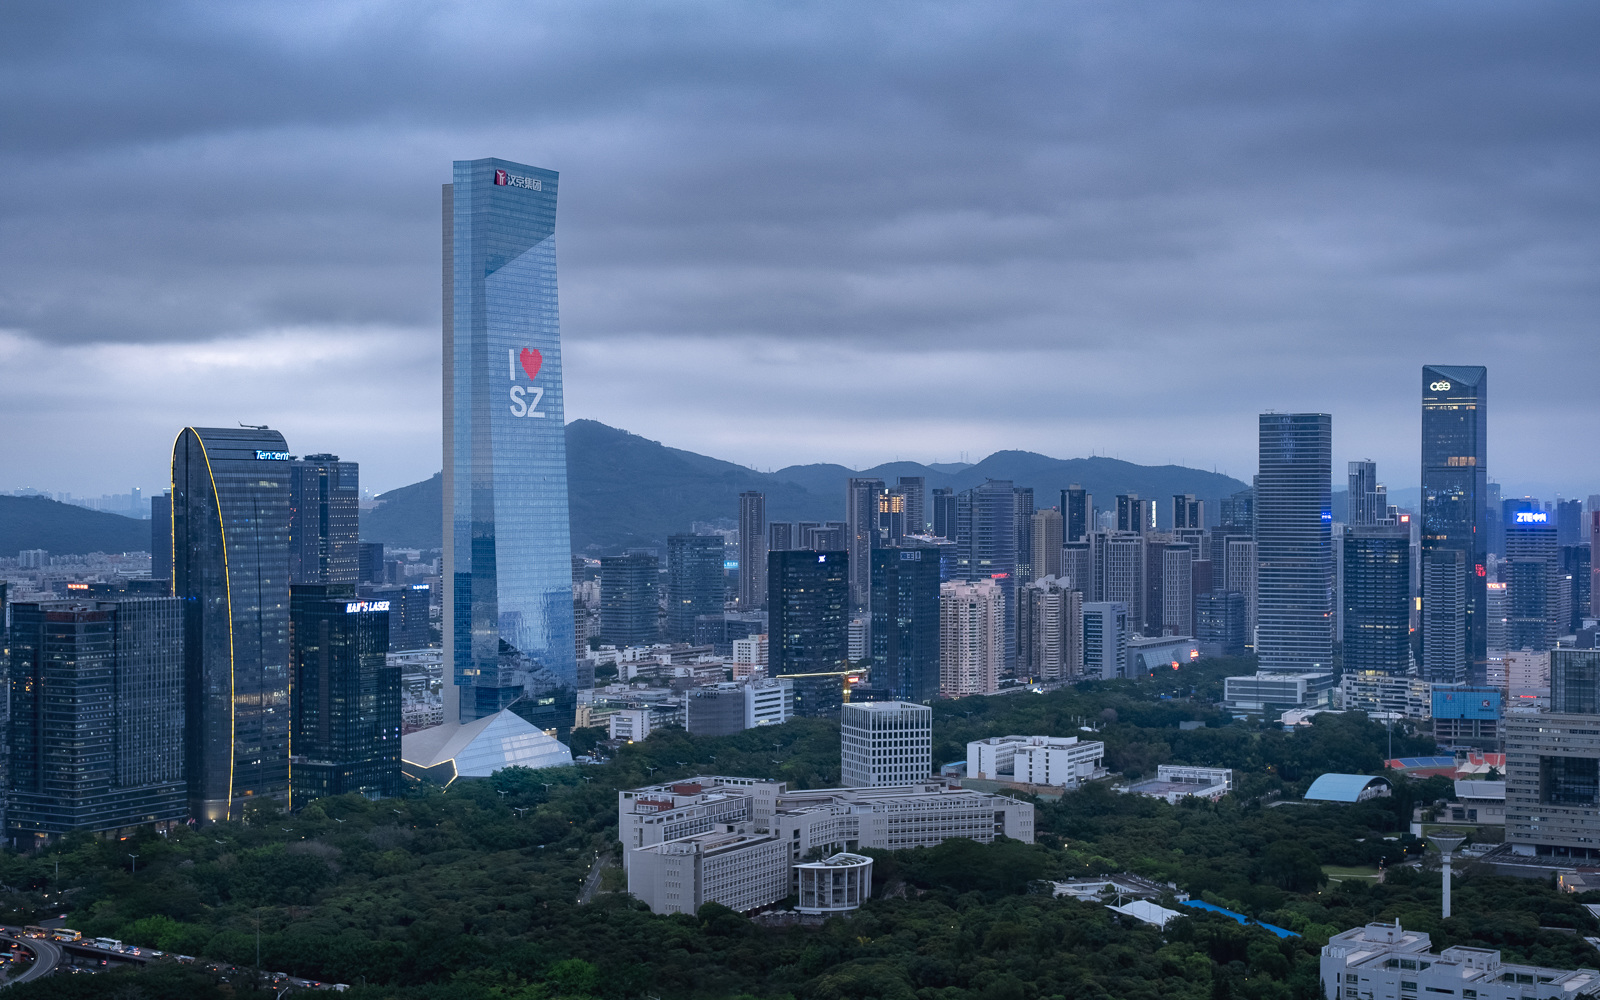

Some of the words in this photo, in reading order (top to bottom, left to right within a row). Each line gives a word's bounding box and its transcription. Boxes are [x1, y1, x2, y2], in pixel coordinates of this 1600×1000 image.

[507, 173, 542, 191] 汉京集团
[509, 349, 515, 381] I
[509, 386, 545, 418] SZ
[256, 450, 290, 460] Tencent
[369, 601, 390, 611] LASER
